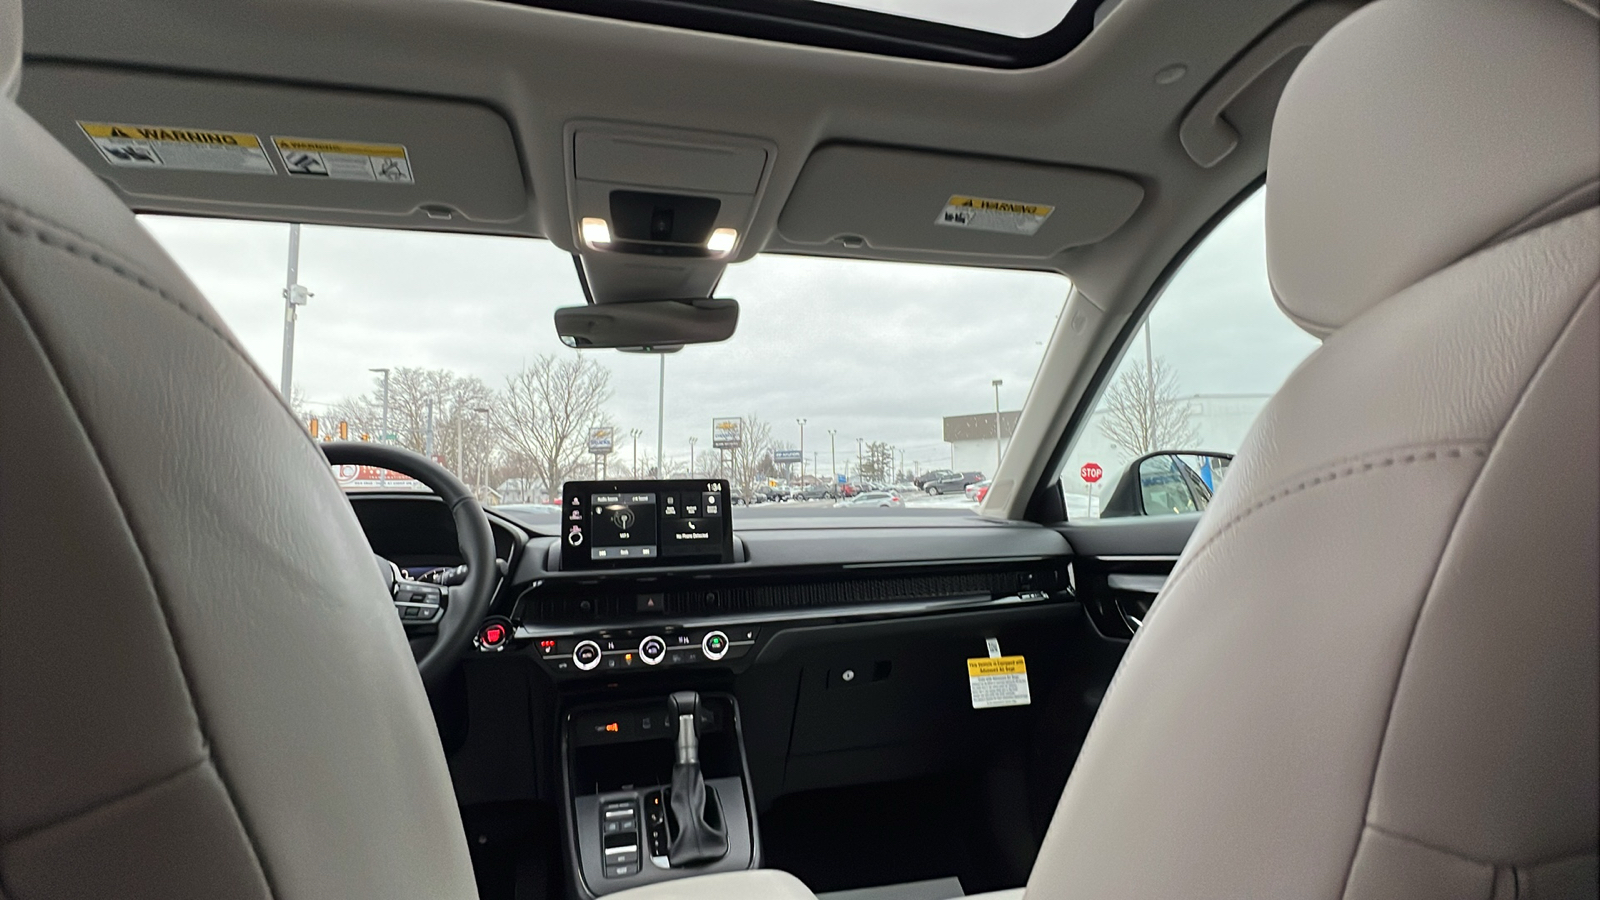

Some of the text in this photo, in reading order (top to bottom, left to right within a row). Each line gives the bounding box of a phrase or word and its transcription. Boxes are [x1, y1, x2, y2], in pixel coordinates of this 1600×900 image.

[137, 127, 239, 145] WARNING
[981, 200, 1038, 214] WARNING
[1081, 467, 1102, 478] STOP
